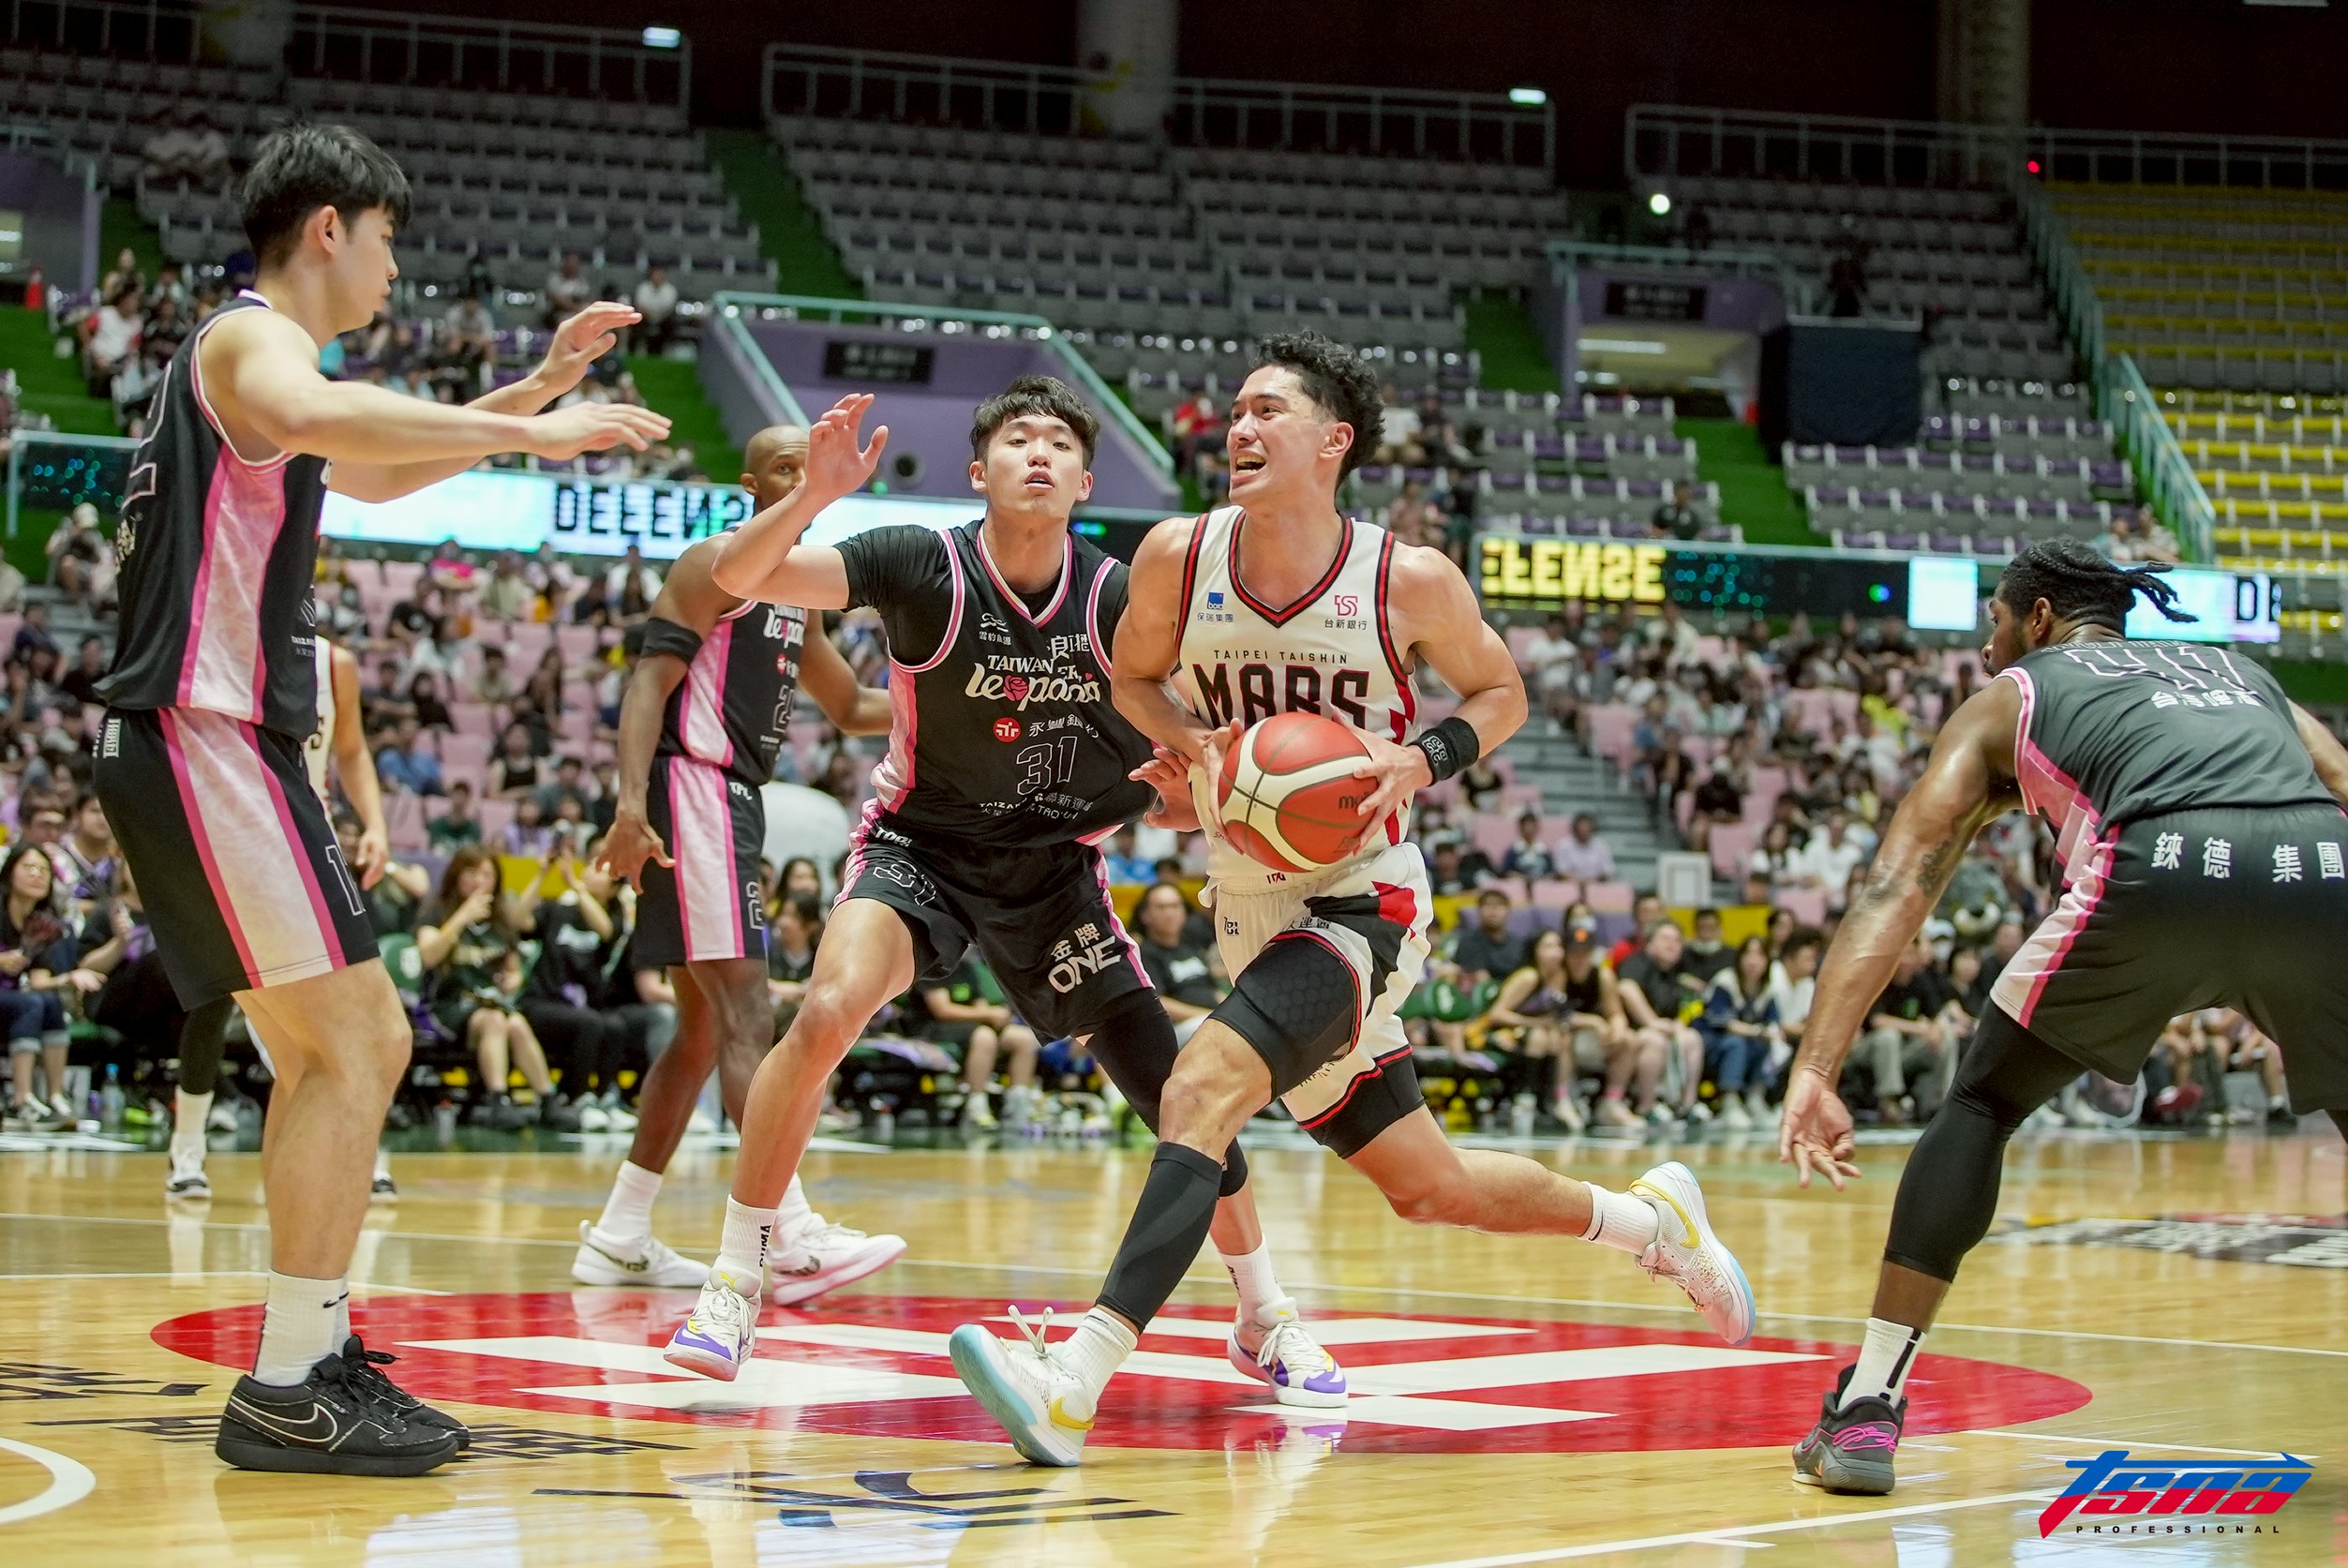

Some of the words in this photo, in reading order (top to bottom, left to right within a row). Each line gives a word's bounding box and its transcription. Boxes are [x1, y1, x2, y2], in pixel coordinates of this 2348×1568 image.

[1324, 619, 1368, 631] 台新銀行
[987, 654, 1055, 674] TAIWAN
[1214, 650, 1268, 660] TAIPEI
[1279, 651, 1348, 665] TAISHIN
[1192, 663, 1370, 731] MARS
[1016, 736, 1078, 796] 31
[2150, 831, 2345, 883] 錸德集團
[1048, 935, 1121, 993] ONE
[1050, 922, 1101, 963] 金牌
